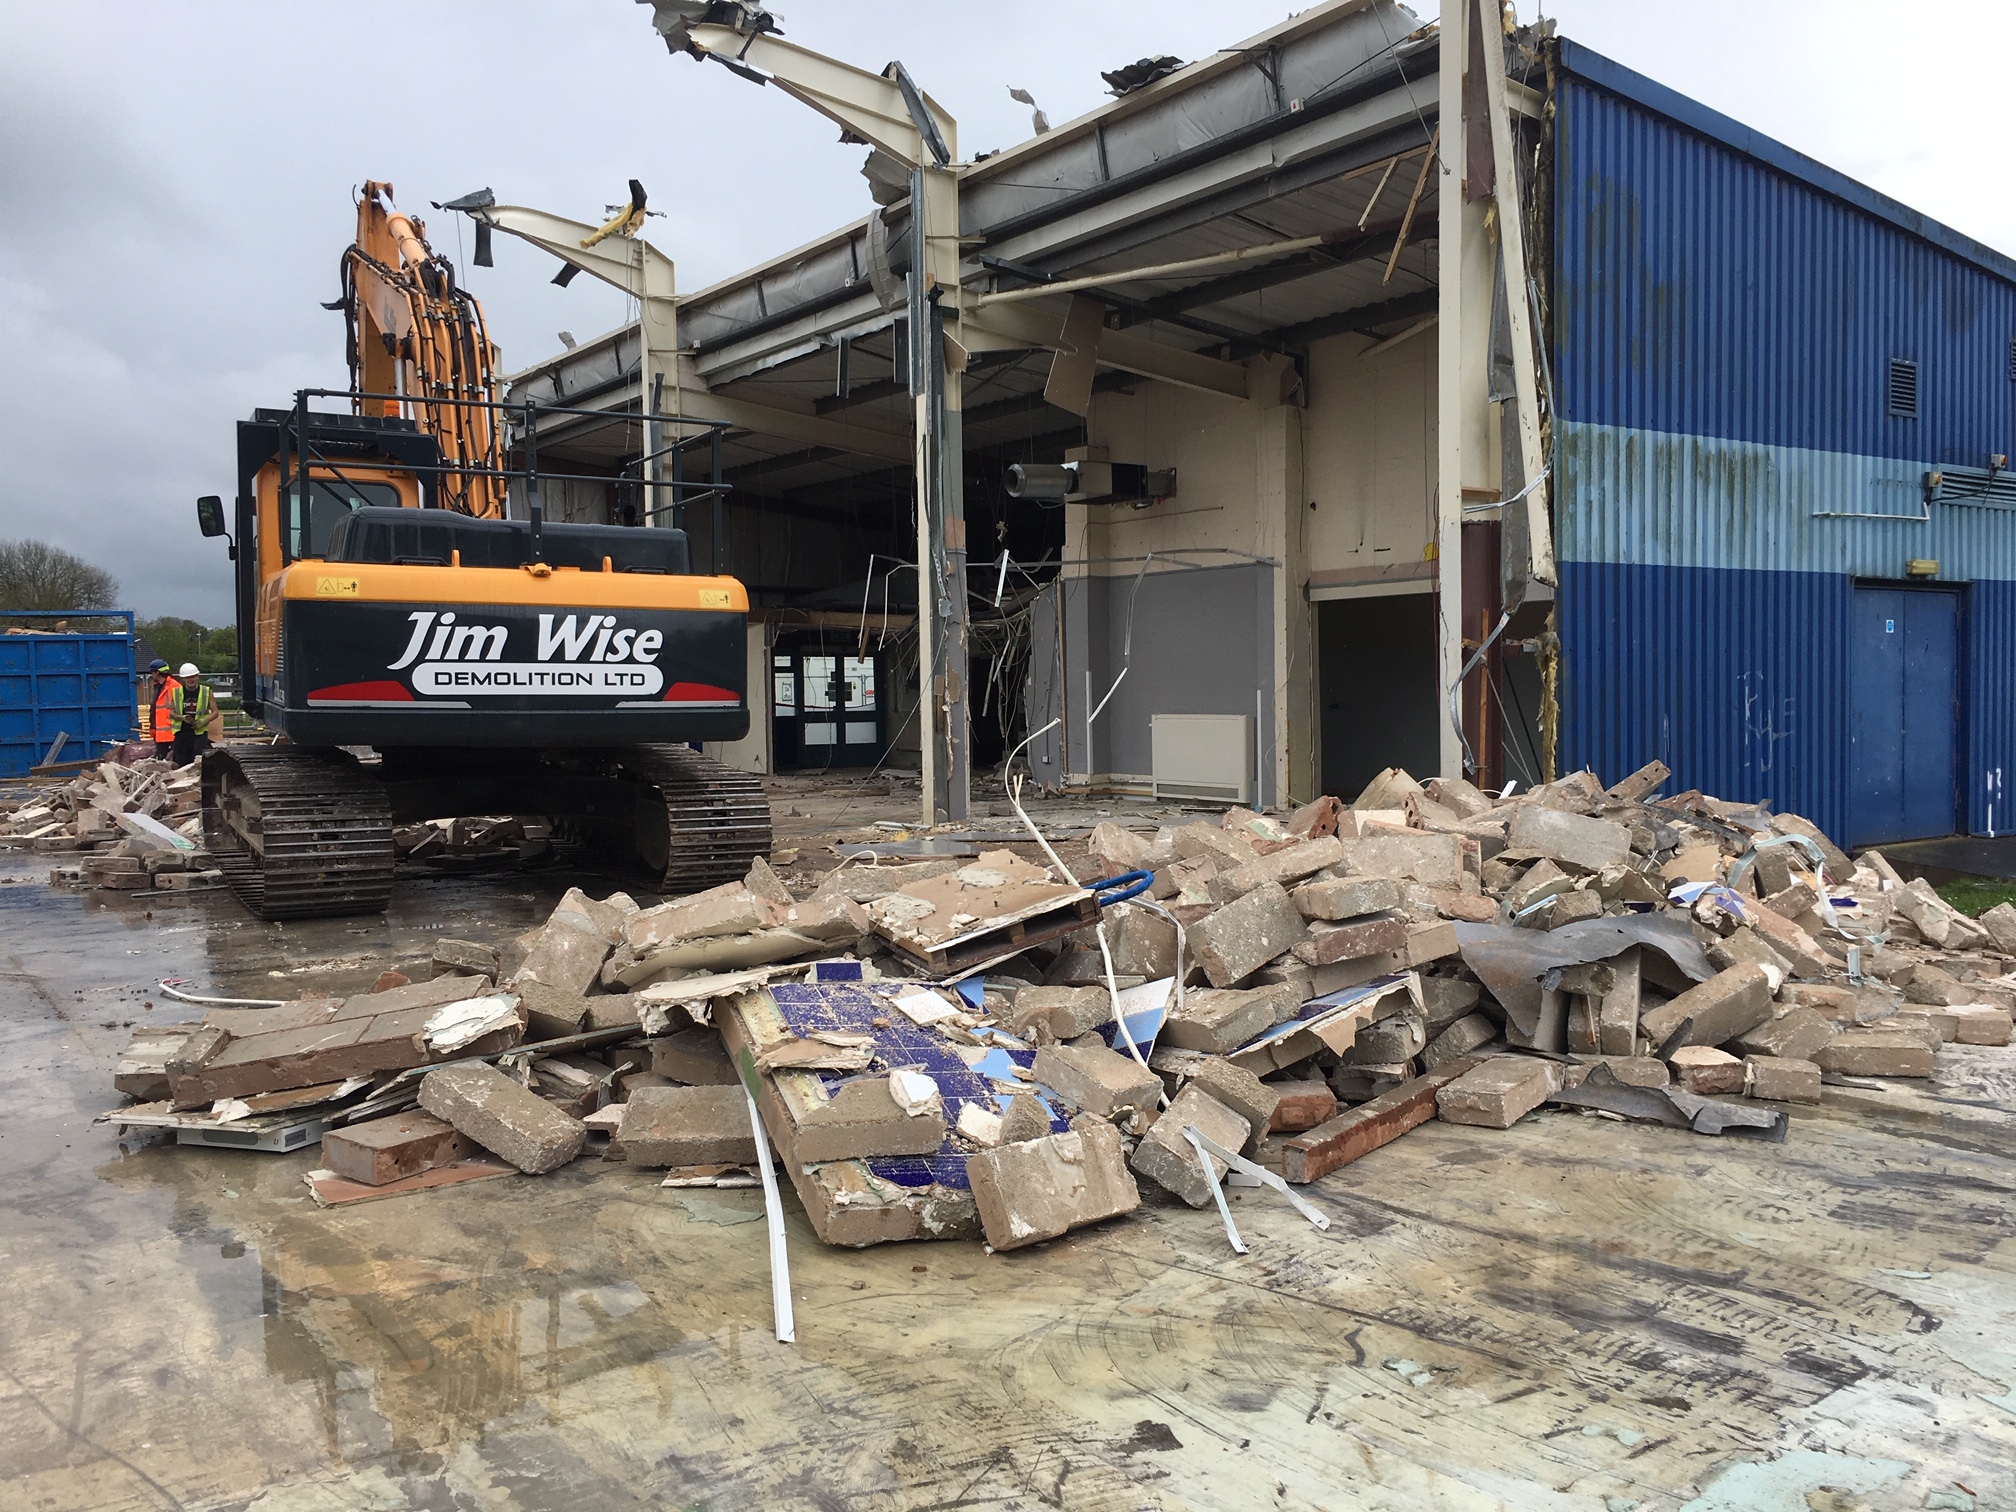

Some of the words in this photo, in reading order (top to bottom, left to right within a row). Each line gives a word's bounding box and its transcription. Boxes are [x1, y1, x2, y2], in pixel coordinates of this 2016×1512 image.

[387, 611, 509, 670] Jim
[537, 613, 664, 663] Wise
[434, 671, 593, 687] DEMOLITION
[604, 672, 646, 687] LTD
